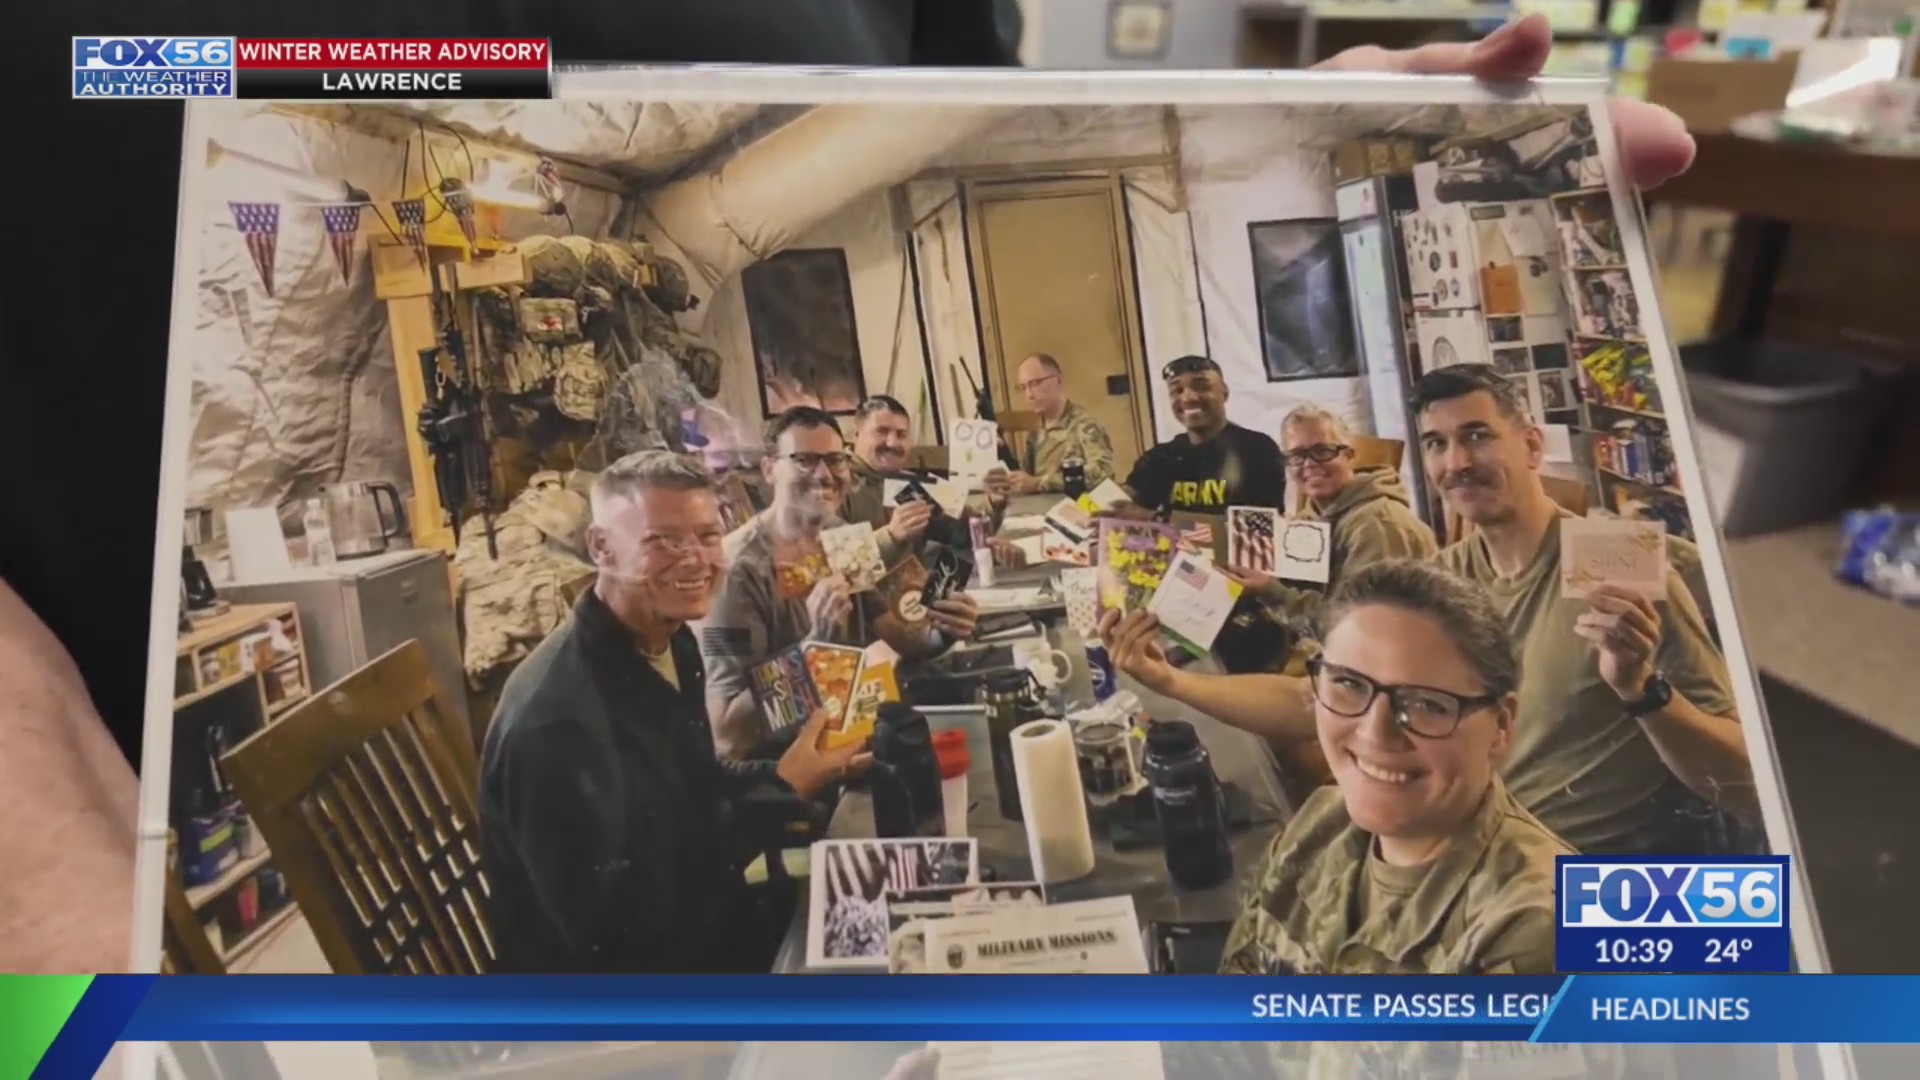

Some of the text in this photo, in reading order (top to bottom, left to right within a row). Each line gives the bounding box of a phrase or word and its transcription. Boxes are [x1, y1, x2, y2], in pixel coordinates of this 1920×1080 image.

[1171, 479, 1227, 505] ARMY
[977, 928, 1118, 958] MILITARY MISSIONS
